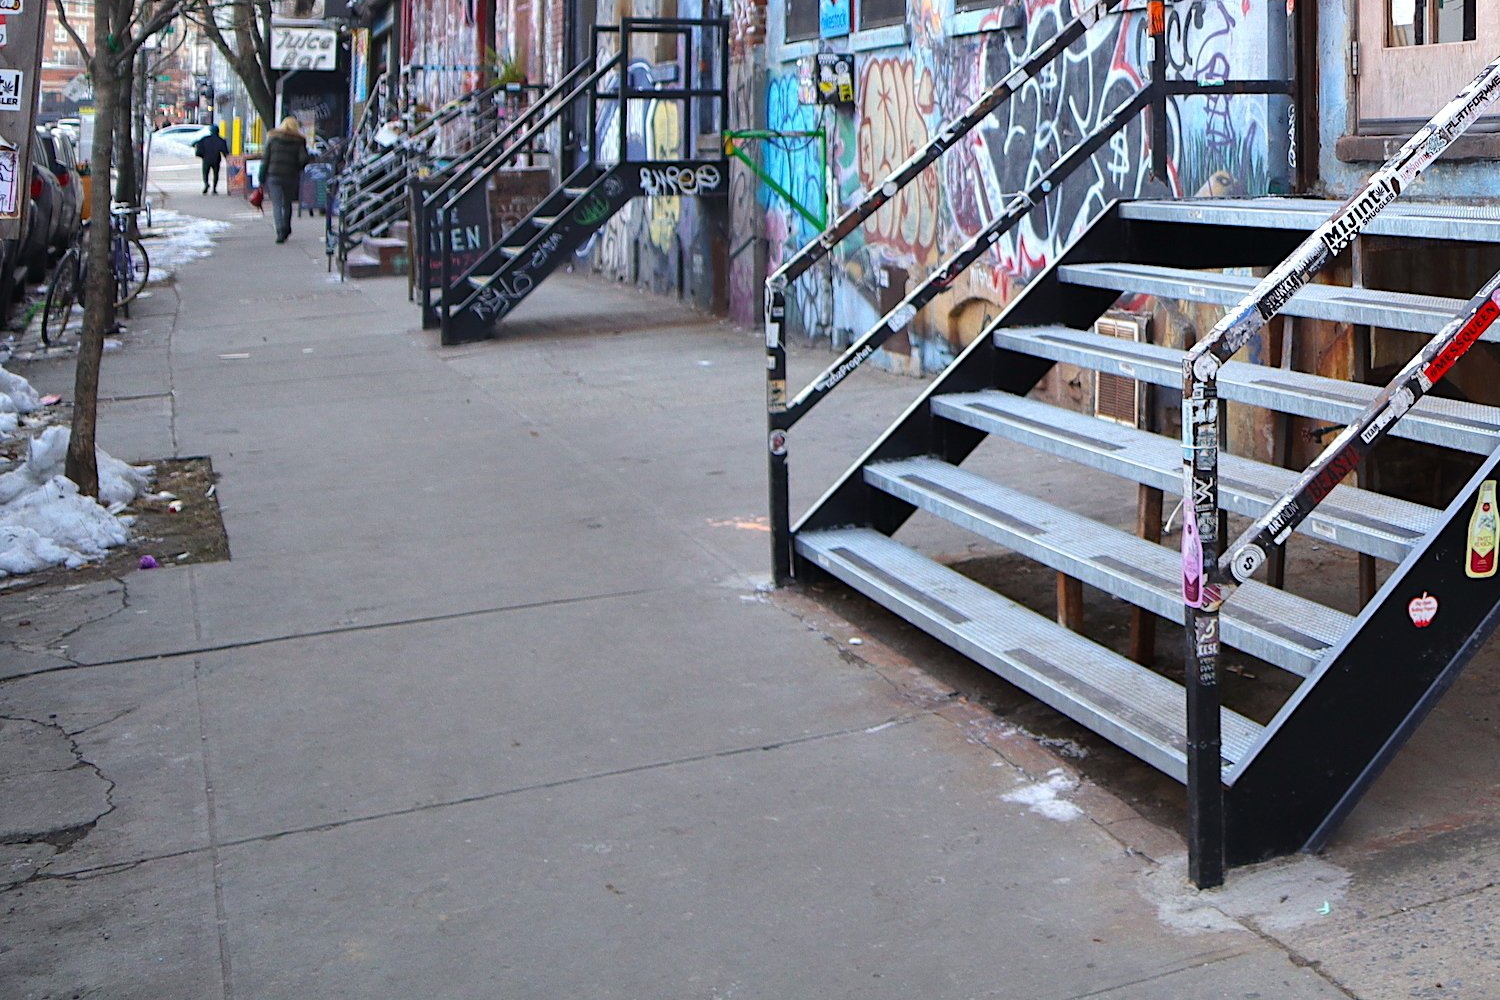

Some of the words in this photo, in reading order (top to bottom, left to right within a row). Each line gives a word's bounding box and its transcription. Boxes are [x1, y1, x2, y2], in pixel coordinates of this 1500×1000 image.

[275, 29, 334, 50] Juice
[280, 49, 327, 71] Bar
[1362, 192, 1396, 226] SMUGGLER
[1430, 306, 1496, 377] #MESSQUEEN
[1364, 423, 1380, 440] TEAM
